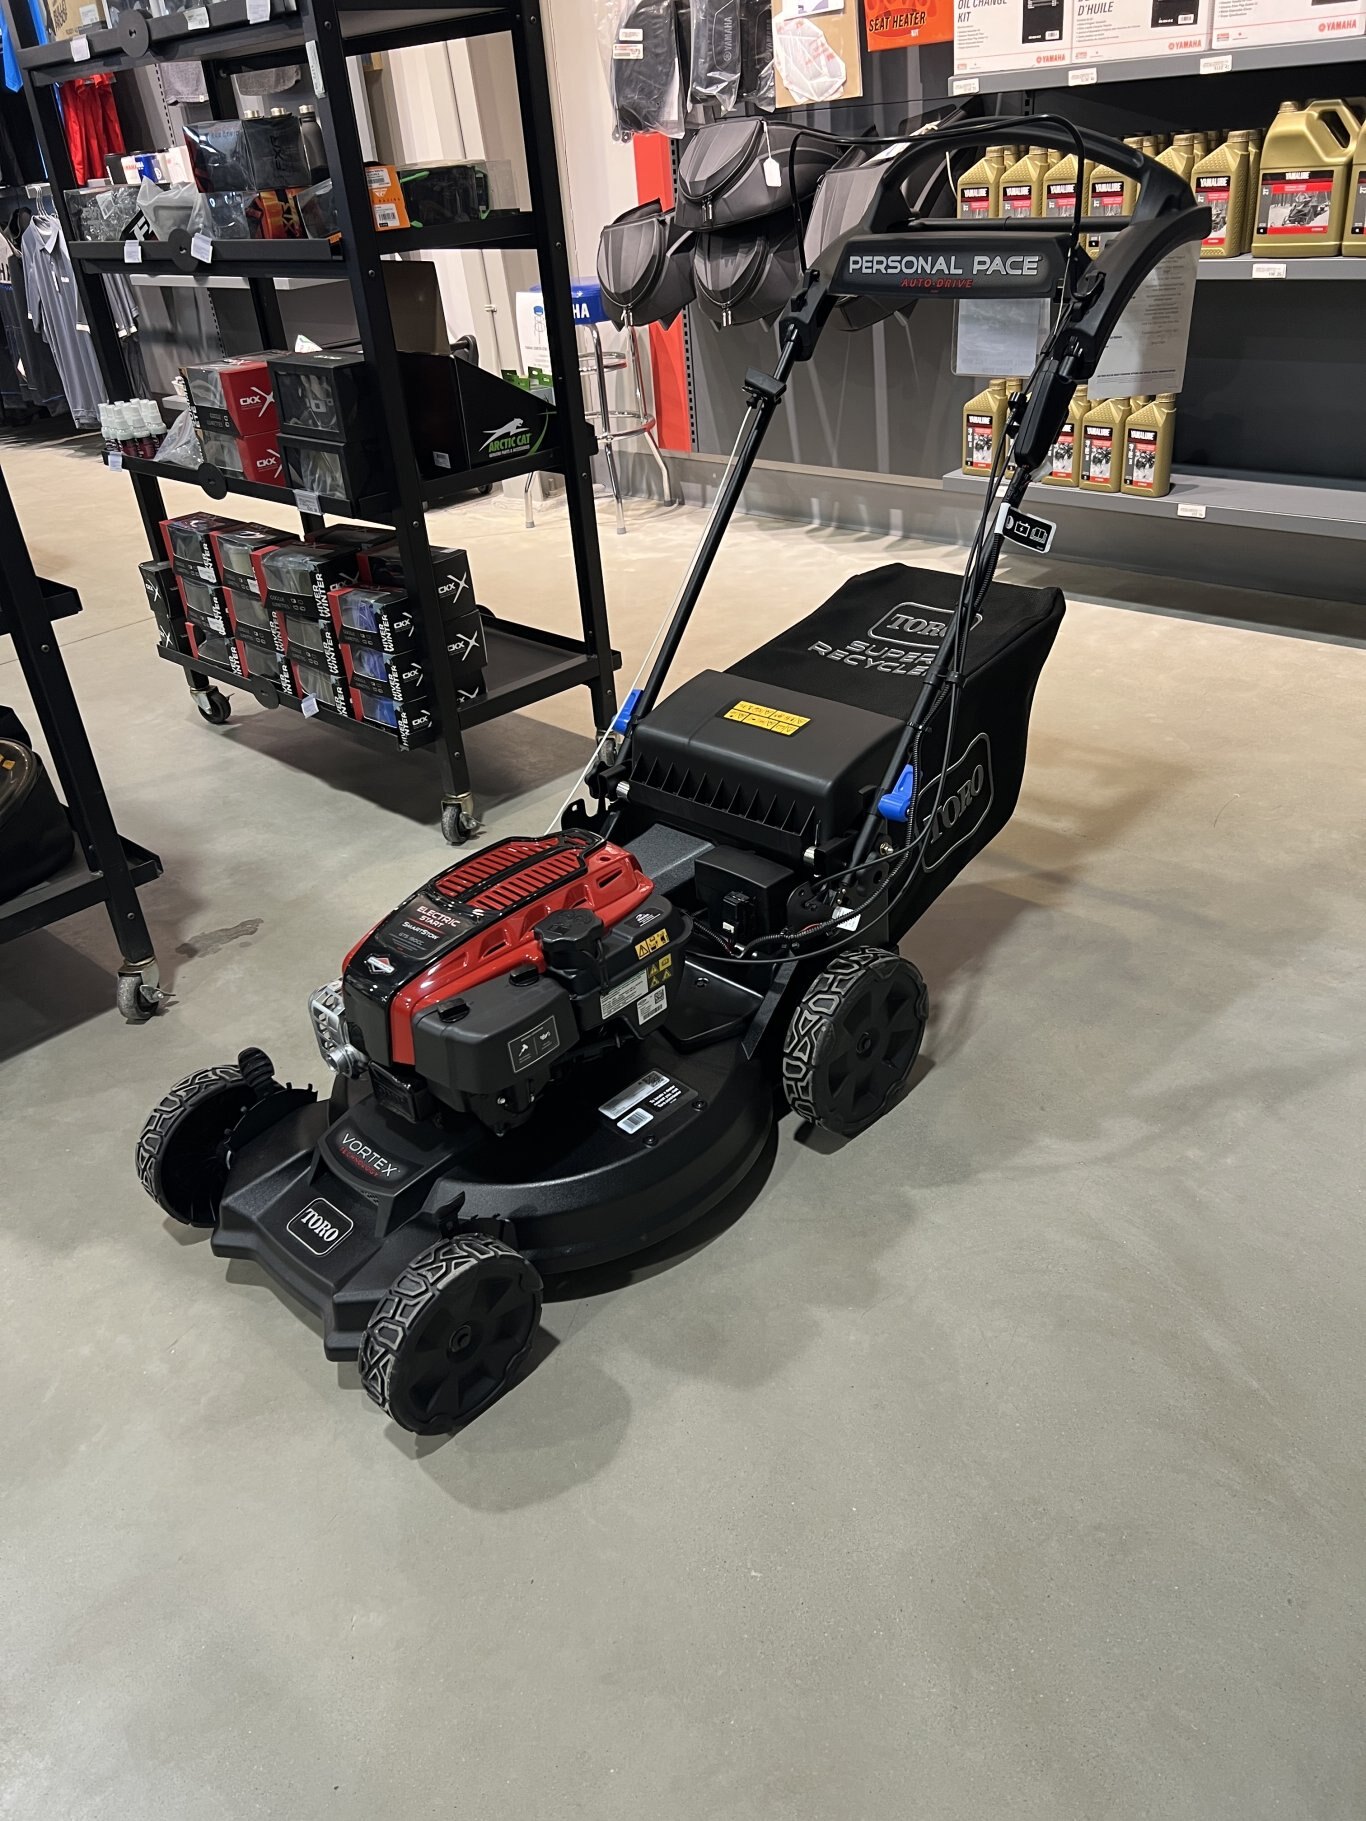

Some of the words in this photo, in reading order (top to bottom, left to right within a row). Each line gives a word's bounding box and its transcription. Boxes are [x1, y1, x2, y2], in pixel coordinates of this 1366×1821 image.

[958, 0, 970, 9] OIL
[1078, 1, 1114, 16] D'HUILE
[869, 14, 889, 32] SEAT
[893, 11, 926, 29] HEATER
[958, 11, 971, 23] KIT
[1327, 20, 1357, 31] YAMAHA
[724, 16, 733, 51] YAMAHA
[1175, 40, 1201, 50] YAMAHA
[1042, 54, 1065, 64] YAMAHA
[1005, 186, 1030, 197] YAMALUBE
[1094, 182, 1123, 193] YAMALUBE
[1200, 177, 1228, 188] YAMALUBE
[963, 188, 987, 198] YAMALUBE
[849, 255, 963, 275] PERSONAL
[972, 255, 1042, 275] PACE
[240, 395, 262, 406] CKX
[969, 415, 991, 424] YAMALUBE
[1086, 427, 1111, 436] YAMALUBE
[1130, 430, 1155, 440] YAMALUBE
[489, 437, 516, 452] ARCTIC
[517, 432, 531, 444] CAT
[257, 457, 277, 468] CKX
[316, 573, 331, 617] WINTER
[438, 583, 455, 594] CKX
[313, 584, 325, 617] HIVER
[382, 614, 394, 652] WINTER
[394, 619, 411, 629] CKX
[270, 620, 281, 652] HIVER
[379, 623, 389, 652] HIVER
[325, 632, 339, 674] WINTER
[447, 641, 465, 652] CKX
[845, 640, 937, 665] SUPER
[229, 655, 237, 674] VER
[231, 646, 242, 675] INTER
[323, 642, 334, 673] HIVER
[280, 674, 288, 693] VER
[282, 664, 293, 695] INTER
[391, 665, 403, 701] WINTER
[402, 669, 419, 679] CKX
[389, 674, 399, 701] HIVER
[334, 696, 342, 715] VER
[337, 687, 348, 717] NTER
[412, 716, 428, 726] CKX
[922, 764, 985, 844] TORO
[416, 905, 461, 928] ELECTRIC
[419, 915, 445, 928] START
[342, 1133, 398, 1177] VORTEX
[301, 1208, 339, 1242] TORO
